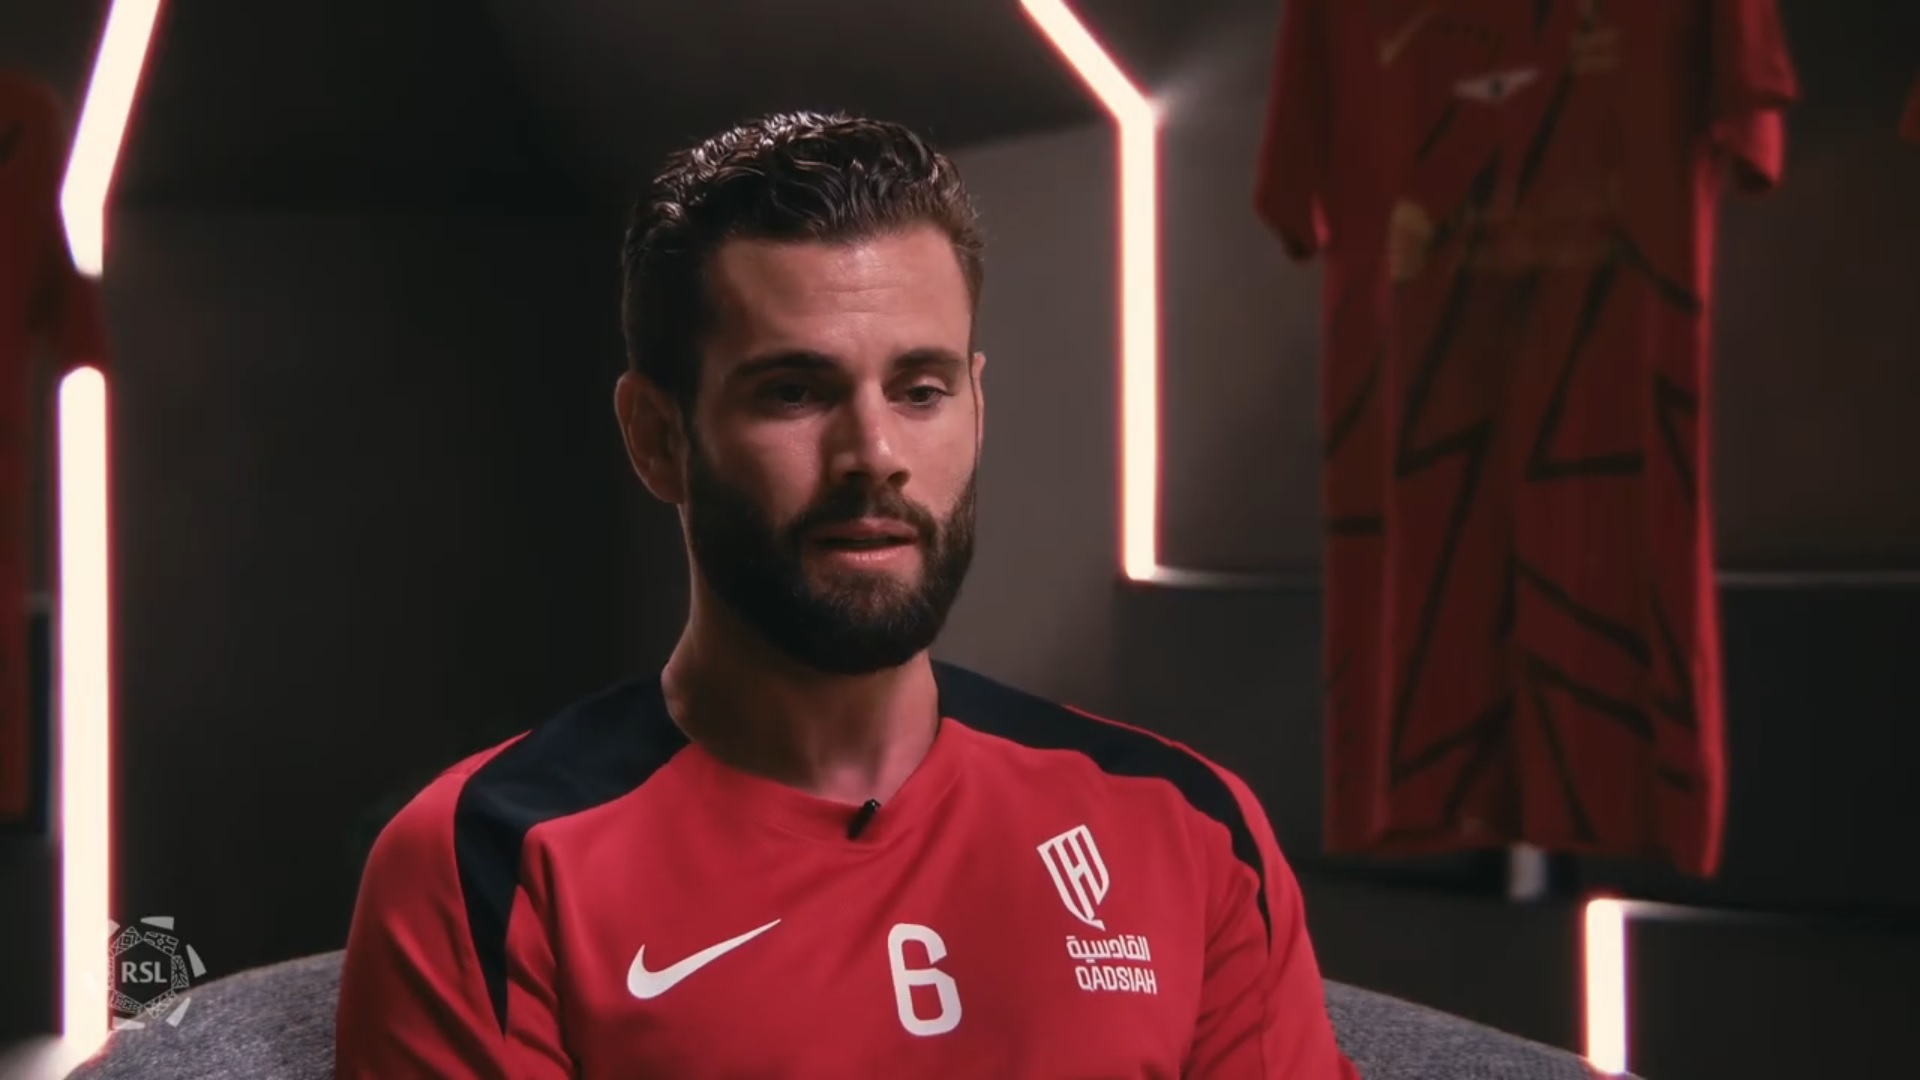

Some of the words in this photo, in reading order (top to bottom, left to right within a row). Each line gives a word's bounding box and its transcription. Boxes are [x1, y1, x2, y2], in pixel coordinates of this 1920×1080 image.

[1066, 934, 1151, 963] القادسية
[888, 922, 962, 1037] 6
[1075, 965, 1158, 995] QADSIAH
